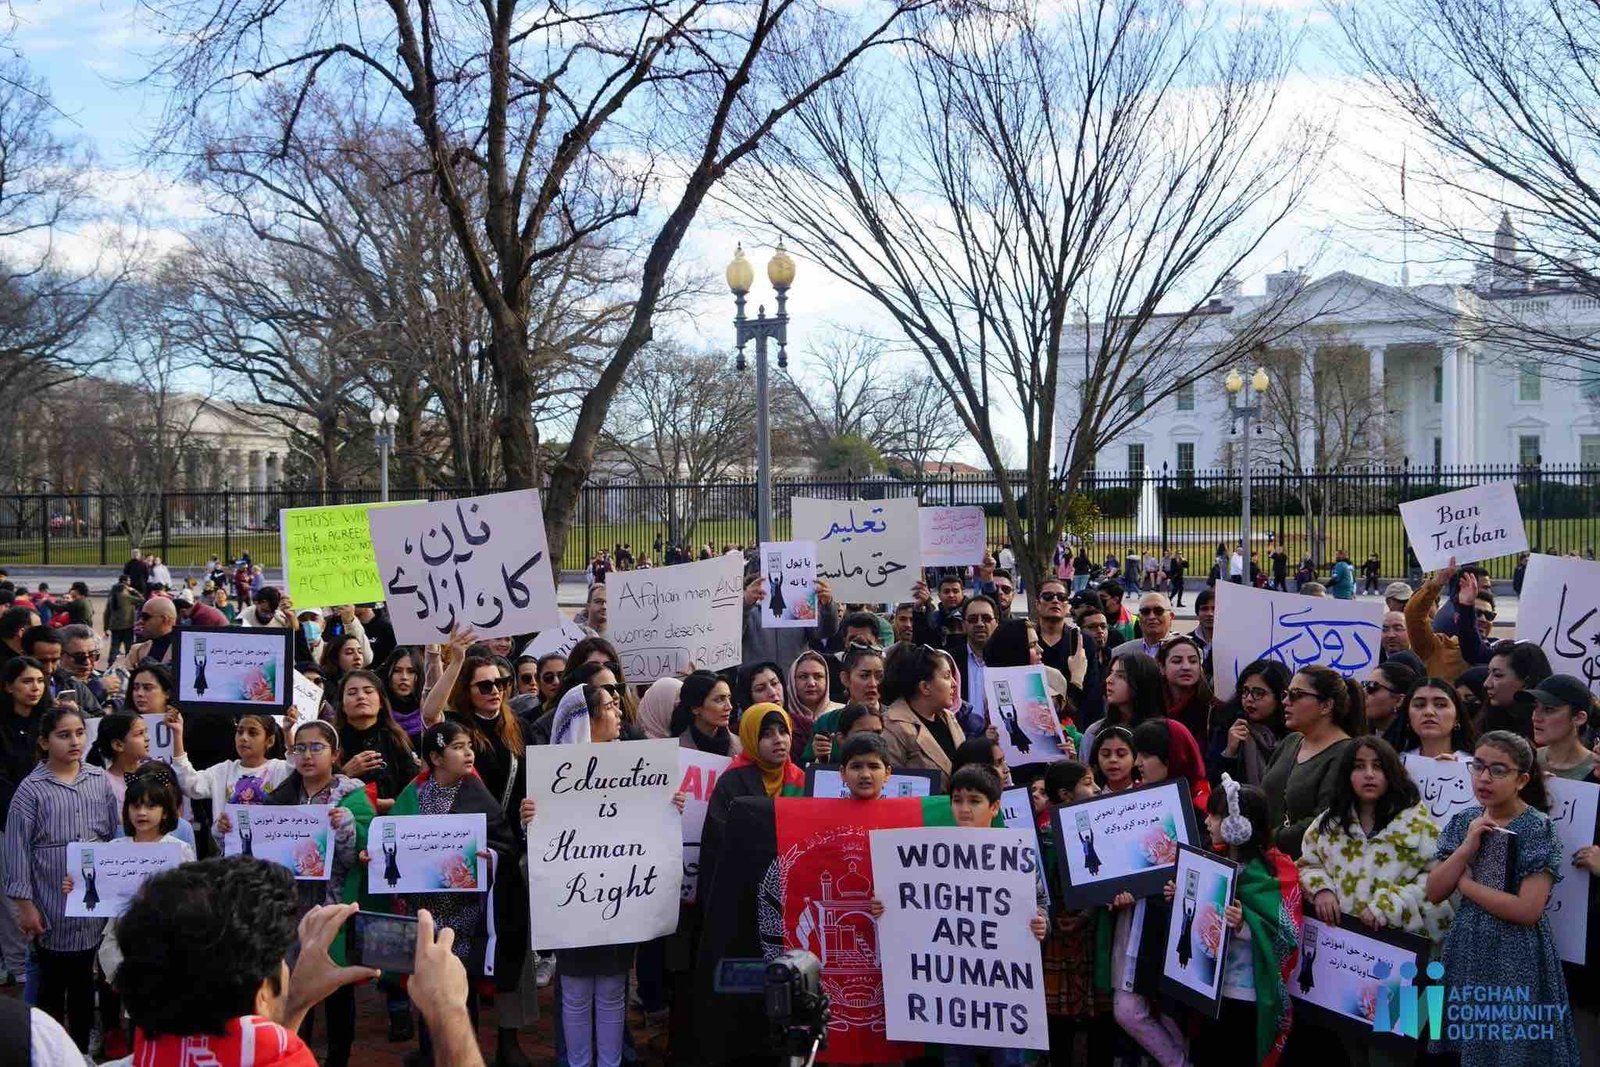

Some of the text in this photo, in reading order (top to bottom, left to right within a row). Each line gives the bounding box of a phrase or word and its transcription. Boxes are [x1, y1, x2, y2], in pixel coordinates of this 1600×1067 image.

[291, 511, 335, 528] THOSE
[818, 507, 887, 543] تعلیم
[1437, 505, 1480, 525] Ban
[294, 531, 319, 544] THE
[294, 542, 338, 557] TALIBAN
[1431, 523, 1508, 551] Taliban
[299, 573, 334, 592] ACT
[866, 551, 907, 587] حق
[618, 575, 742, 622] Afghan men AND
[613, 622, 715, 645] women deserve
[620, 652, 686, 678] EQUAL
[551, 756, 669, 794] Education
[598, 795, 618, 818] is
[543, 829, 647, 863] Human
[897, 839, 1036, 874] WOMEN'S
[557, 864, 658, 921] Right
[898, 882, 1012, 916] RIGHTS
[932, 917, 998, 950] ARE
[1346, 948, 1361, 956] حق
[911, 953, 1034, 990] HUMAN
[907, 993, 1029, 1036] RIGHTS
